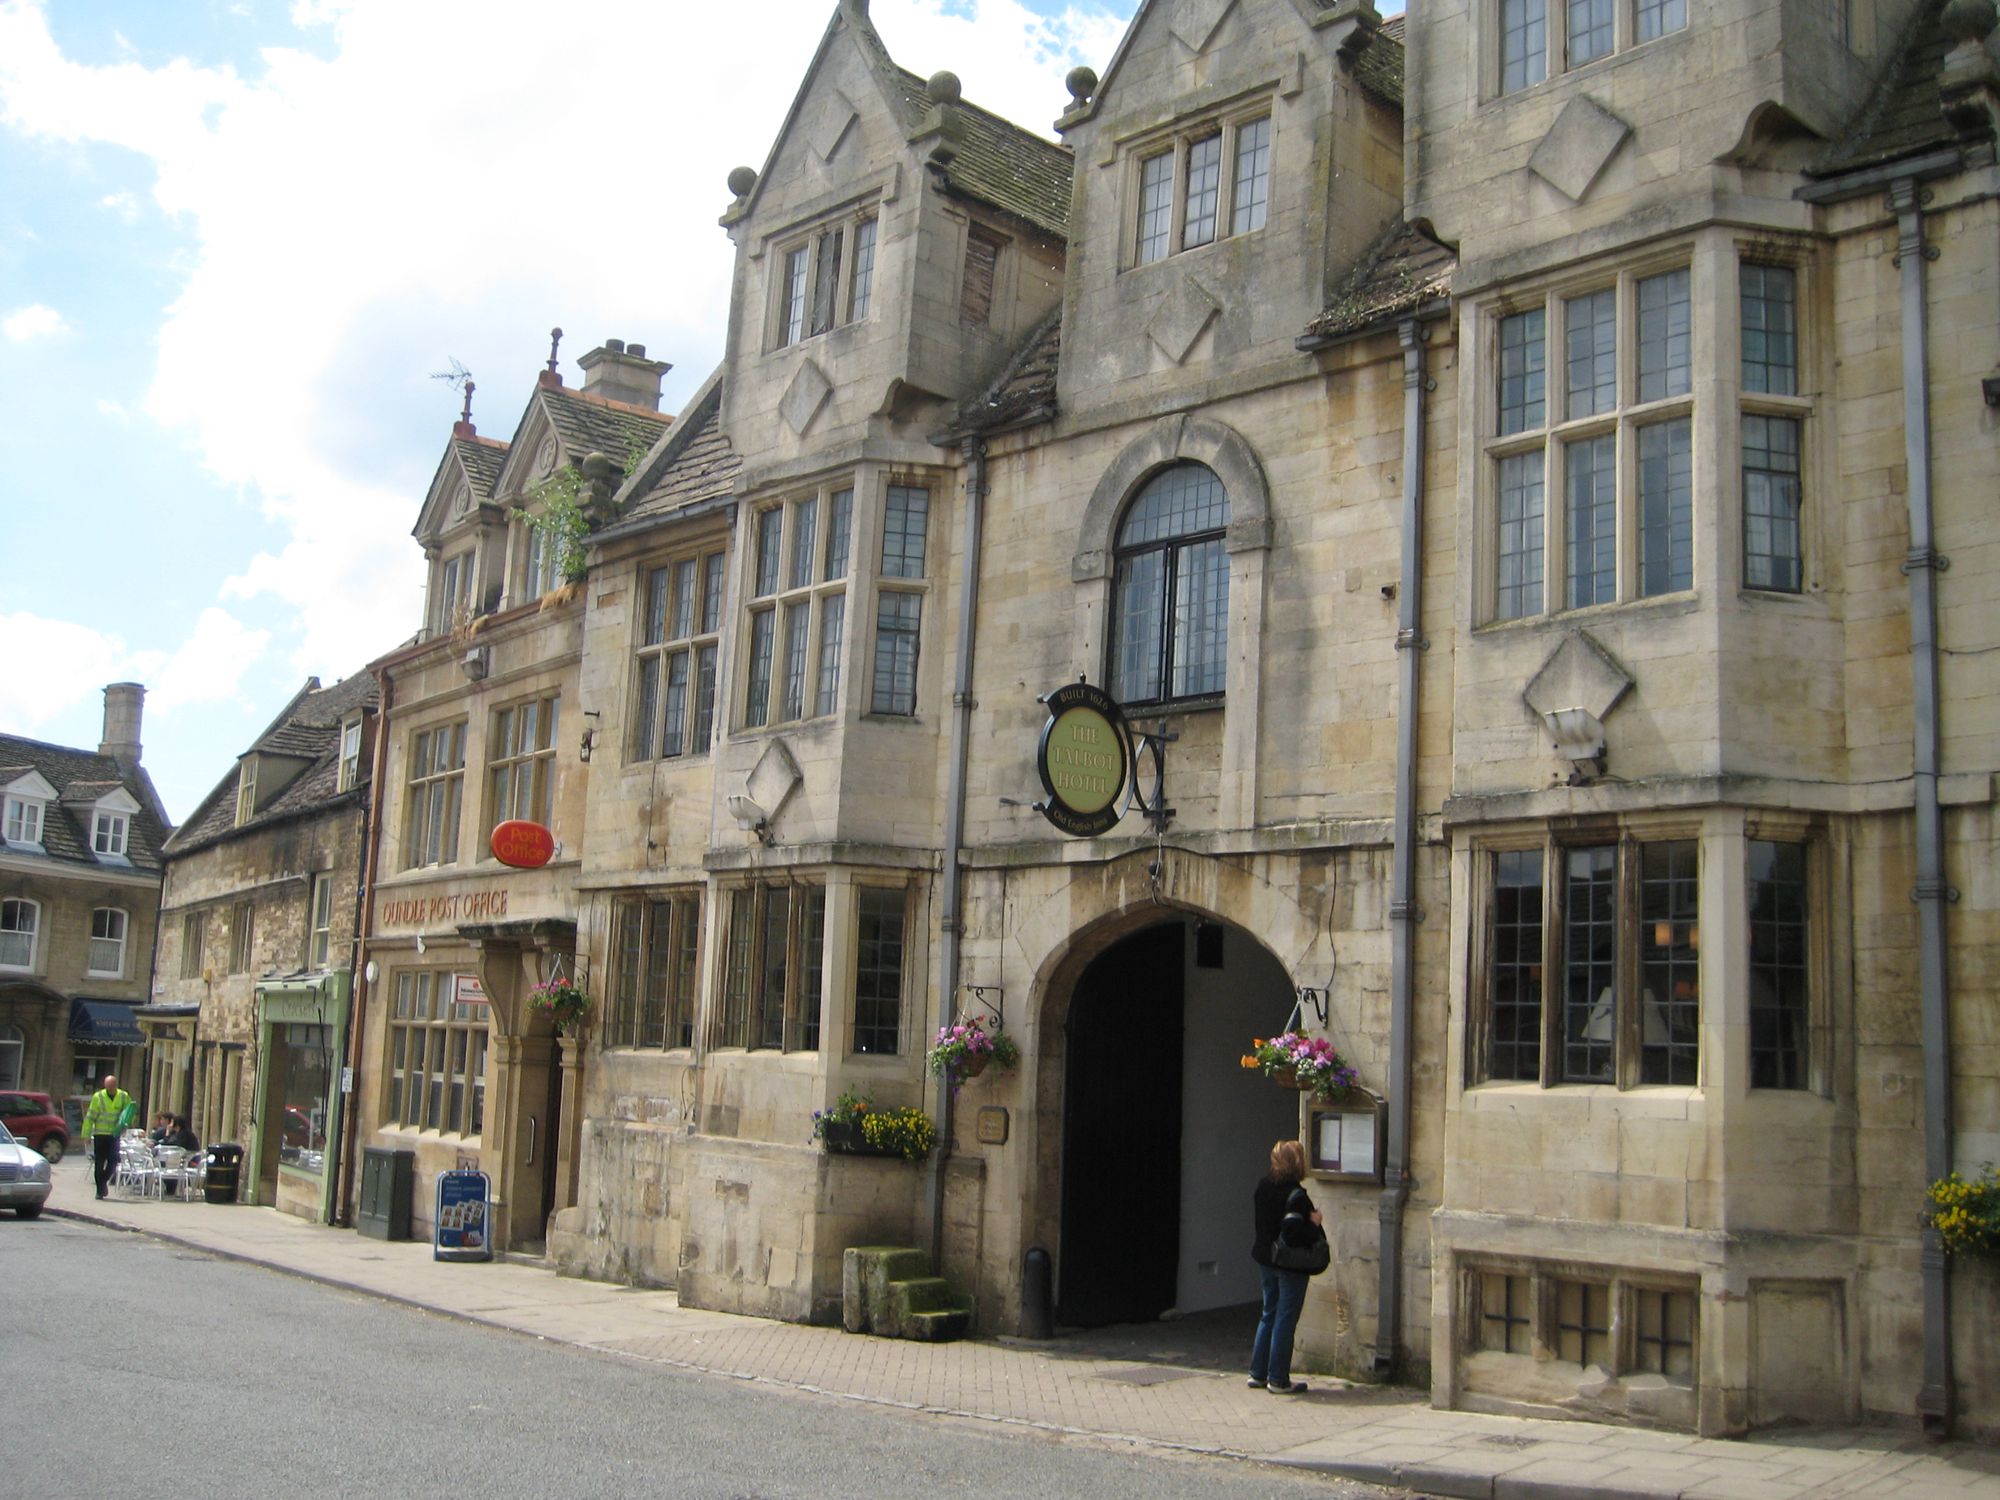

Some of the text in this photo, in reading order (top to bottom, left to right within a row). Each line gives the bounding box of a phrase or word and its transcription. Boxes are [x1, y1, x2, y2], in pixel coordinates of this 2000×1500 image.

[1060, 688, 1085, 703] BUILT
[1071, 724, 1099, 744] THE
[1053, 745, 1115, 771] TALBOT
[1058, 770, 1109, 794] HOTEL
[511, 827, 542, 845] Post
[502, 842, 546, 860] Office
[383, 890, 508, 926] OUNDLE POST OFFICE
